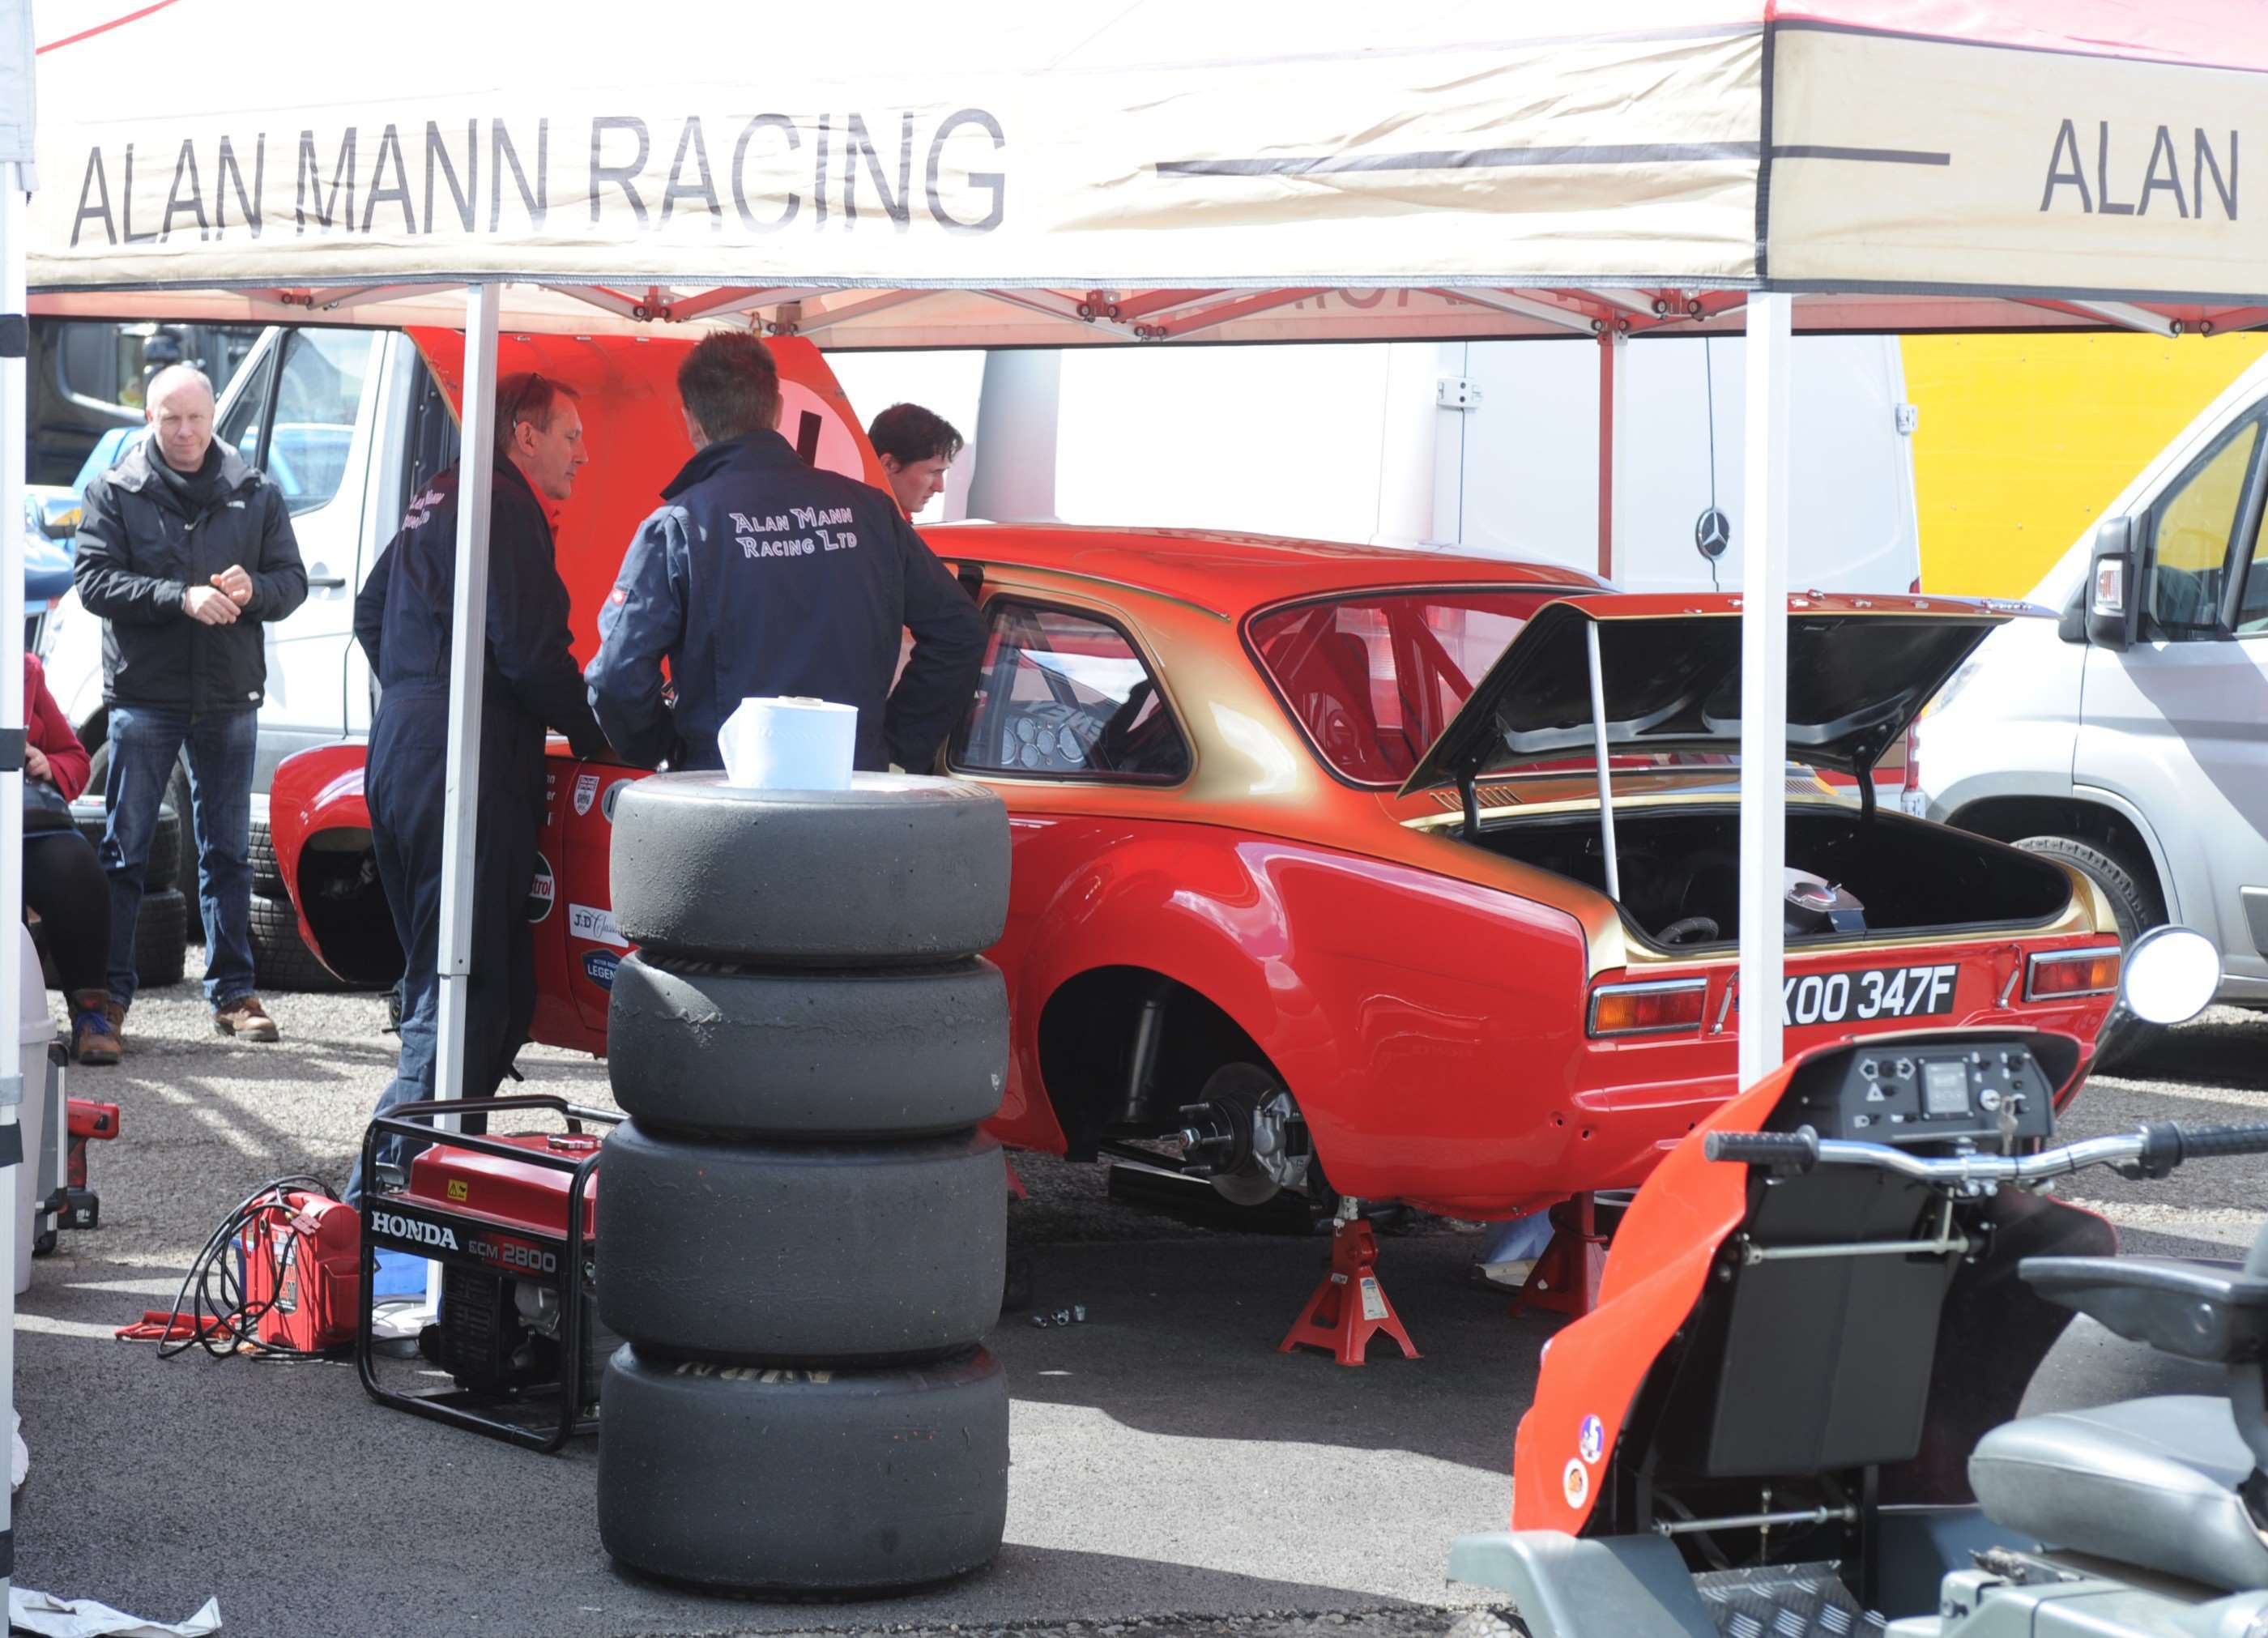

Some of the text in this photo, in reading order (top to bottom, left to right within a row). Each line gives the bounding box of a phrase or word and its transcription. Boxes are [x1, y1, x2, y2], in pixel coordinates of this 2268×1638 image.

[70, 109, 1005, 250] ALAN MANN RACING
[2040, 118, 2238, 220] ALAN
[729, 506, 853, 534] ALAN MANN
[735, 536, 815, 558] RACING
[533, 878, 552, 896] trol
[587, 963, 616, 980] LEGEN
[1857, 965, 1956, 1019] 347F
[371, 1211, 458, 1251] HONDA
[502, 1243, 556, 1273] 2800
